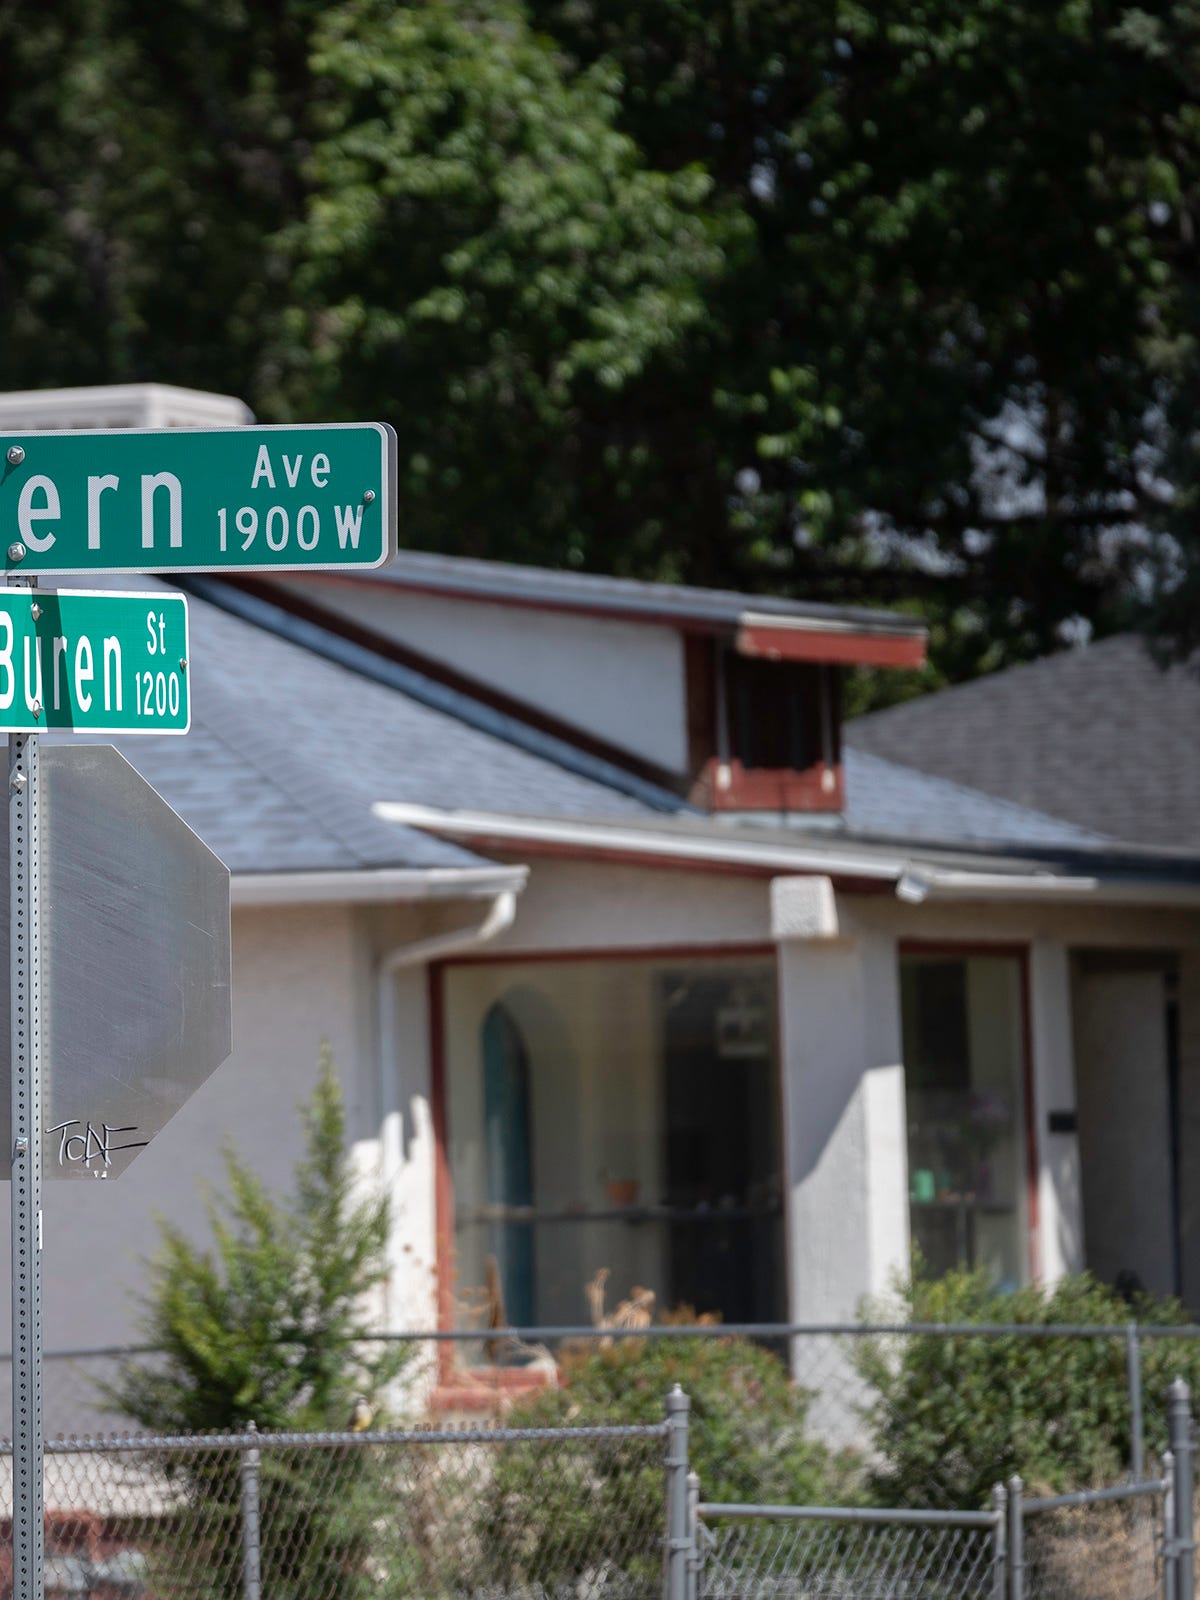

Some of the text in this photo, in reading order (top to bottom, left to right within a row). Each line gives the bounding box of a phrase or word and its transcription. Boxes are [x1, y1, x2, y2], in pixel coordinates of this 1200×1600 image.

[250, 444, 331, 489] Ave
[217, 504, 364, 552] 1900 W
[146, 610, 167, 656] St
[135, 671, 180, 717] 1200
